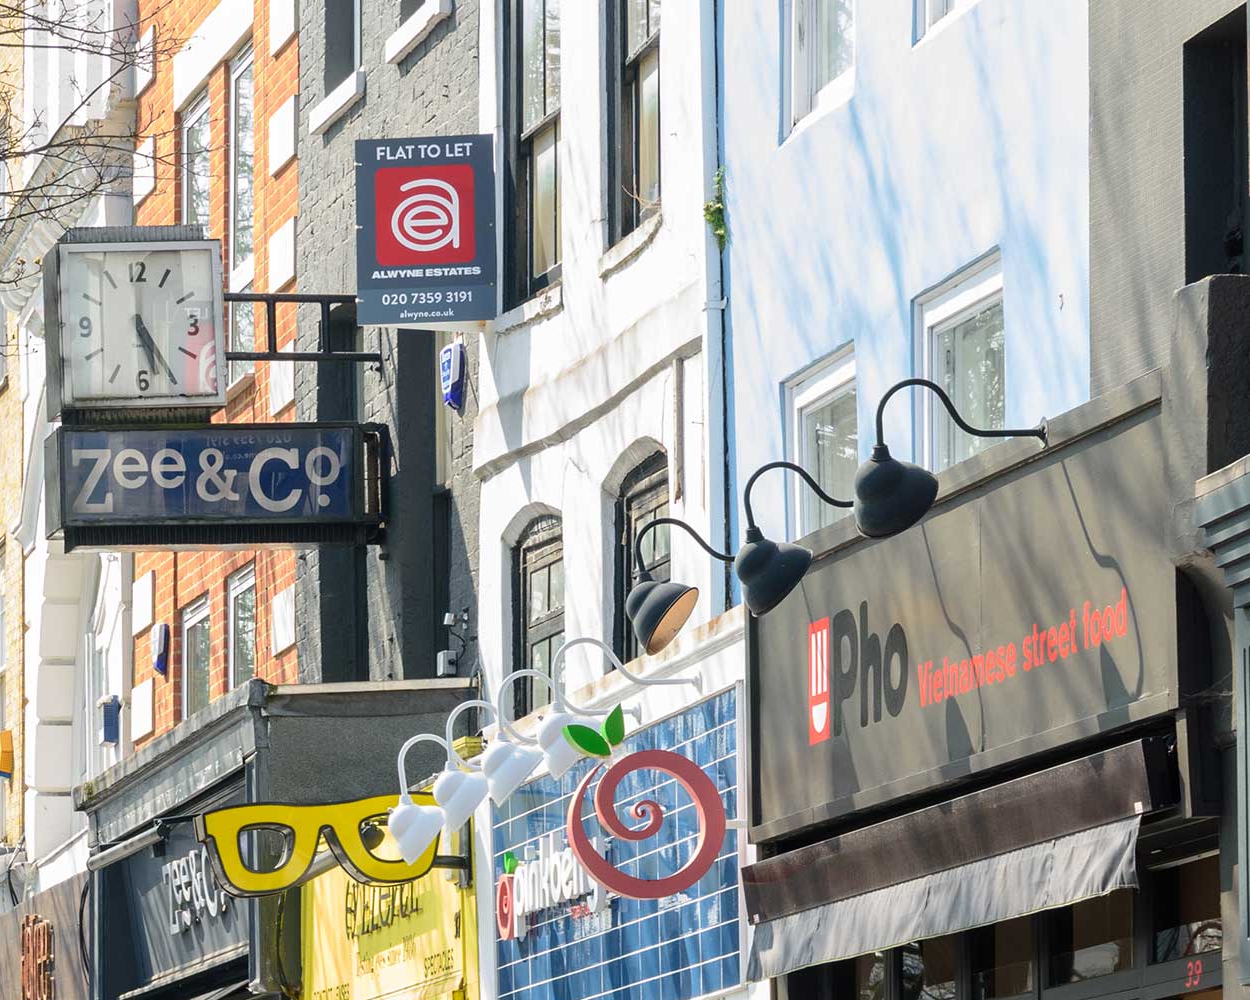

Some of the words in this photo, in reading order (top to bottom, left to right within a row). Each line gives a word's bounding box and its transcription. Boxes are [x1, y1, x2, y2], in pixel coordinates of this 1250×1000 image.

[376, 146, 414, 160] FLAT
[418, 144, 440, 159] TO
[446, 143, 473, 157] LET
[128, 261, 147, 283] 12
[371, 268, 423, 279] ALWYNE
[425, 266, 481, 277] ESTATES
[382, 293, 407, 305] 020
[411, 292, 442, 304] 7359
[446, 291, 472, 302] 3191
[400, 308, 454, 321] alwyne.co.uk
[79, 316, 92, 337] 9
[187, 315, 199, 336] 3
[137, 370, 149, 391] 6
[832, 600, 908, 737] Pho
[917, 641, 1016, 708] Vietnamese
[1022, 608, 1077, 672] street
[1083, 585, 1127, 650] food
[1185, 959, 1203, 988] 39
